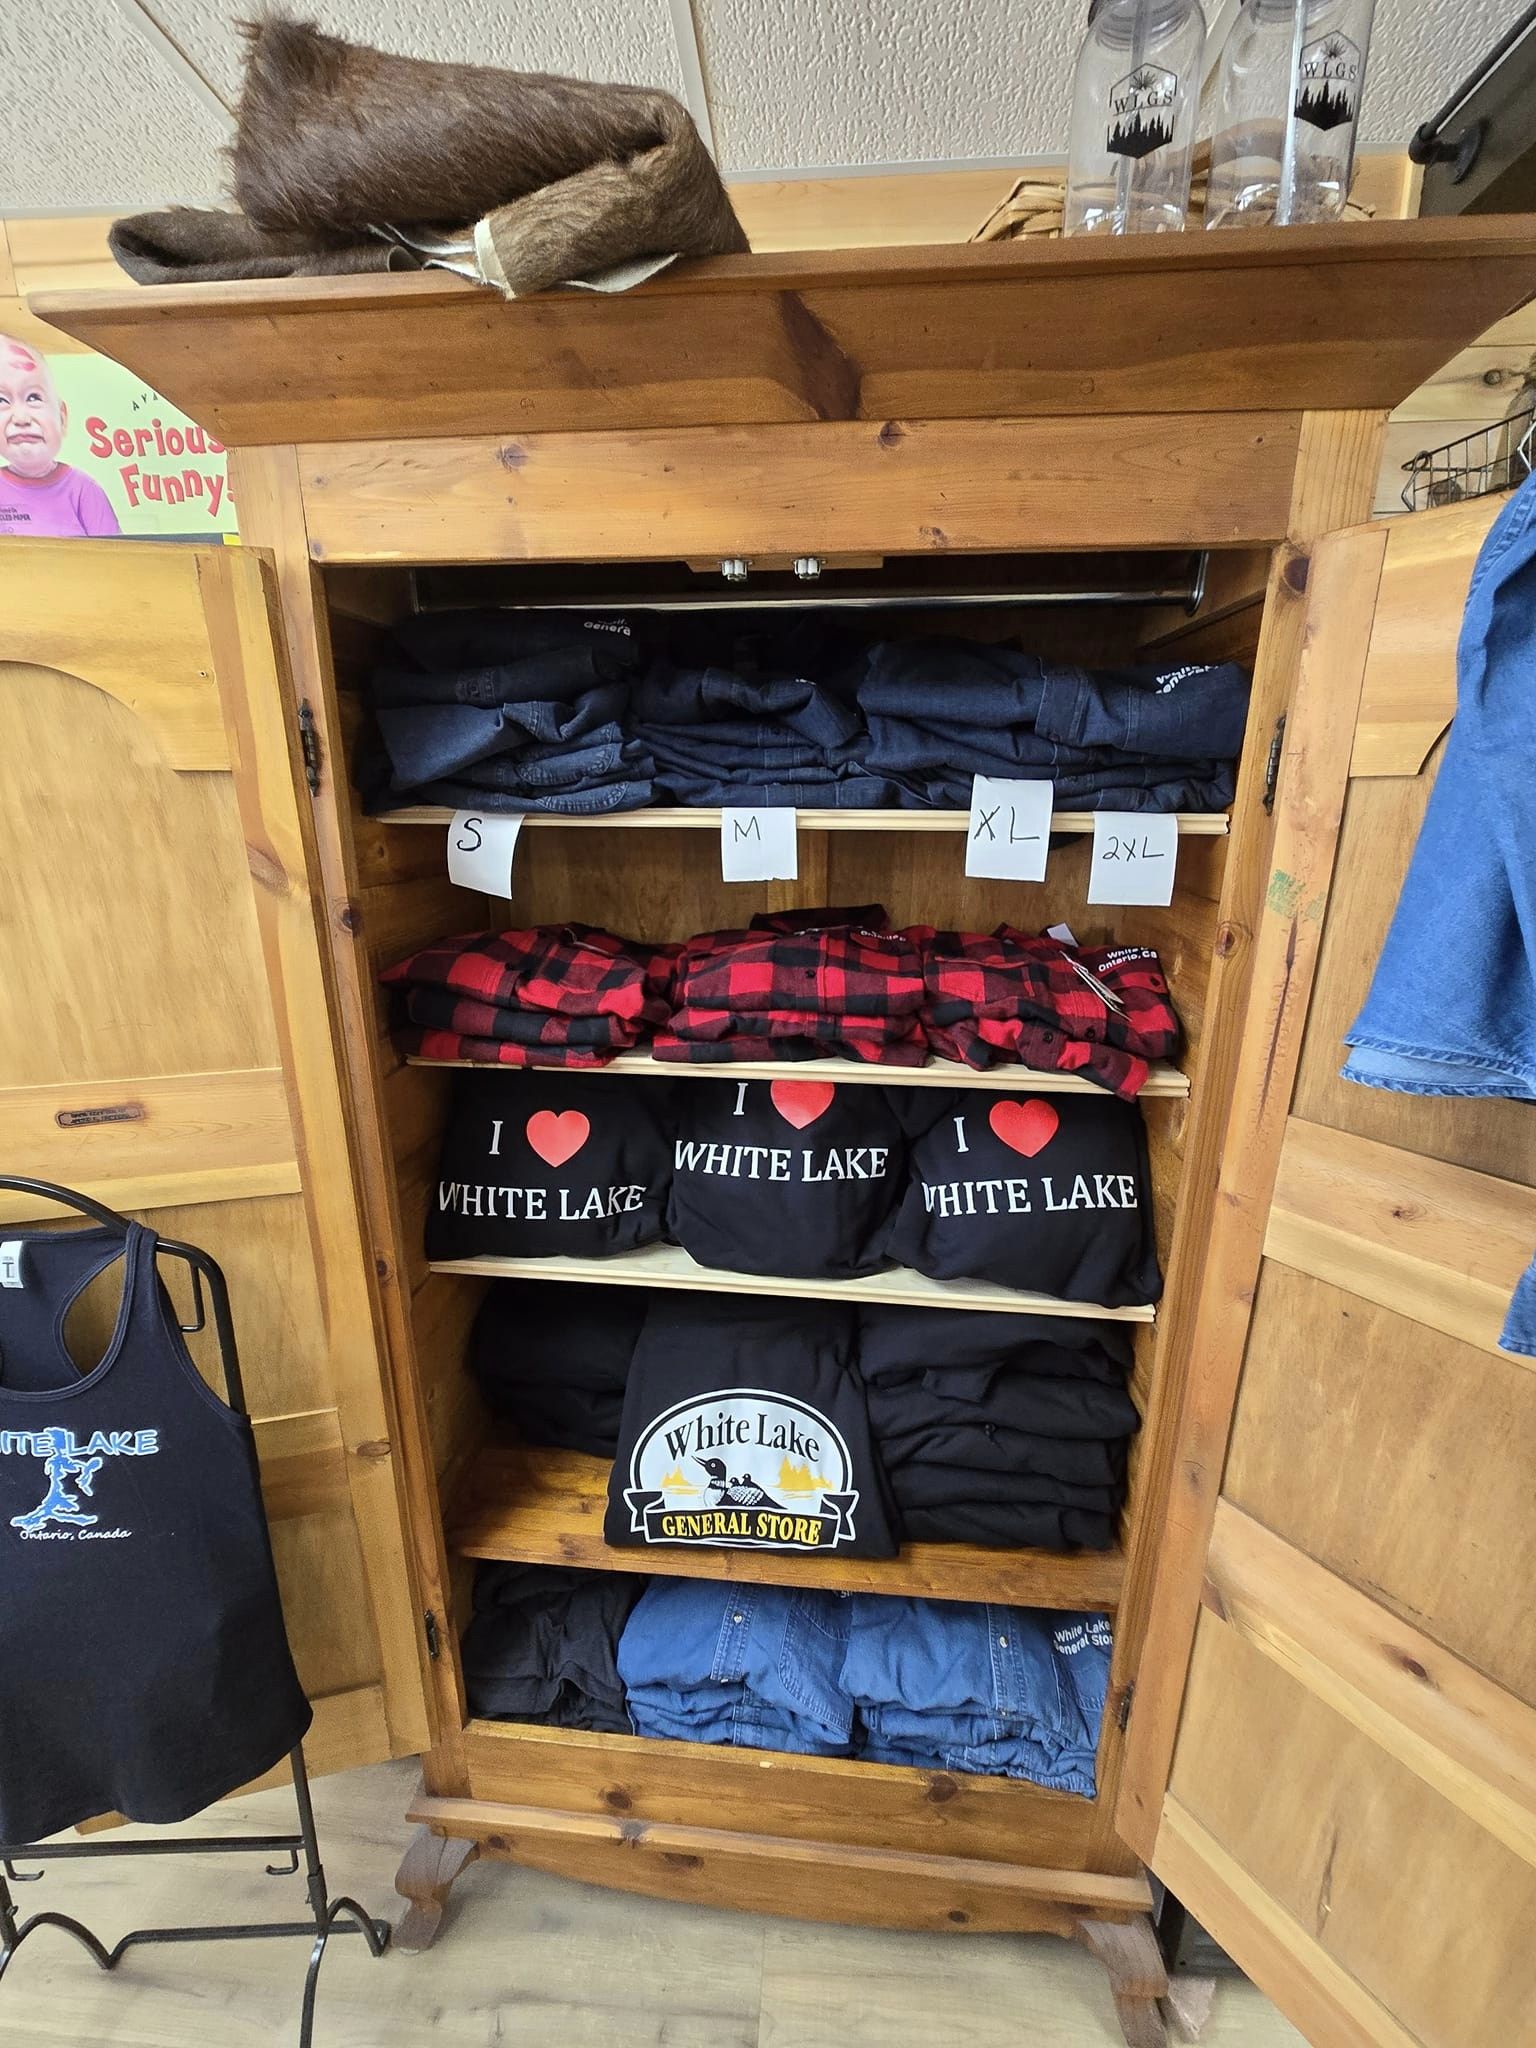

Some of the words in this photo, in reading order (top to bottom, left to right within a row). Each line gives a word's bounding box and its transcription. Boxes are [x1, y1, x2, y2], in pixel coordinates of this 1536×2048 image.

[1304, 61, 1357, 82] WLGS
[1114, 90, 1173, 113] WLGS
[456, 817, 484, 852] S
[734, 815, 761, 842] M
[973, 805, 1040, 844] XL
[1102, 836, 1165, 861] 2XL
[733, 1082, 748, 1116] I
[489, 1120, 503, 1155] I
[953, 1116, 969, 1153] I
[674, 1140, 792, 1181] WHITE
[801, 1147, 889, 1182] LAKE
[438, 1181, 547, 1220] WHITE
[559, 1185, 647, 1221] LAKE
[1040, 1174, 1138, 1212] LAKE
[66, 1429, 159, 1456] LAKE
[664, 1412, 750, 1462] White
[757, 1413, 820, 1462] Lake
[20, 1529, 74, 1541] Ontario,
[78, 1527, 132, 1540] Canada
[662, 1511, 751, 1537] GENERAL
[757, 1512, 822, 1545] STORE
[1055, 1625, 1082, 1643] White
[1085, 1619, 1110, 1633] Lake
